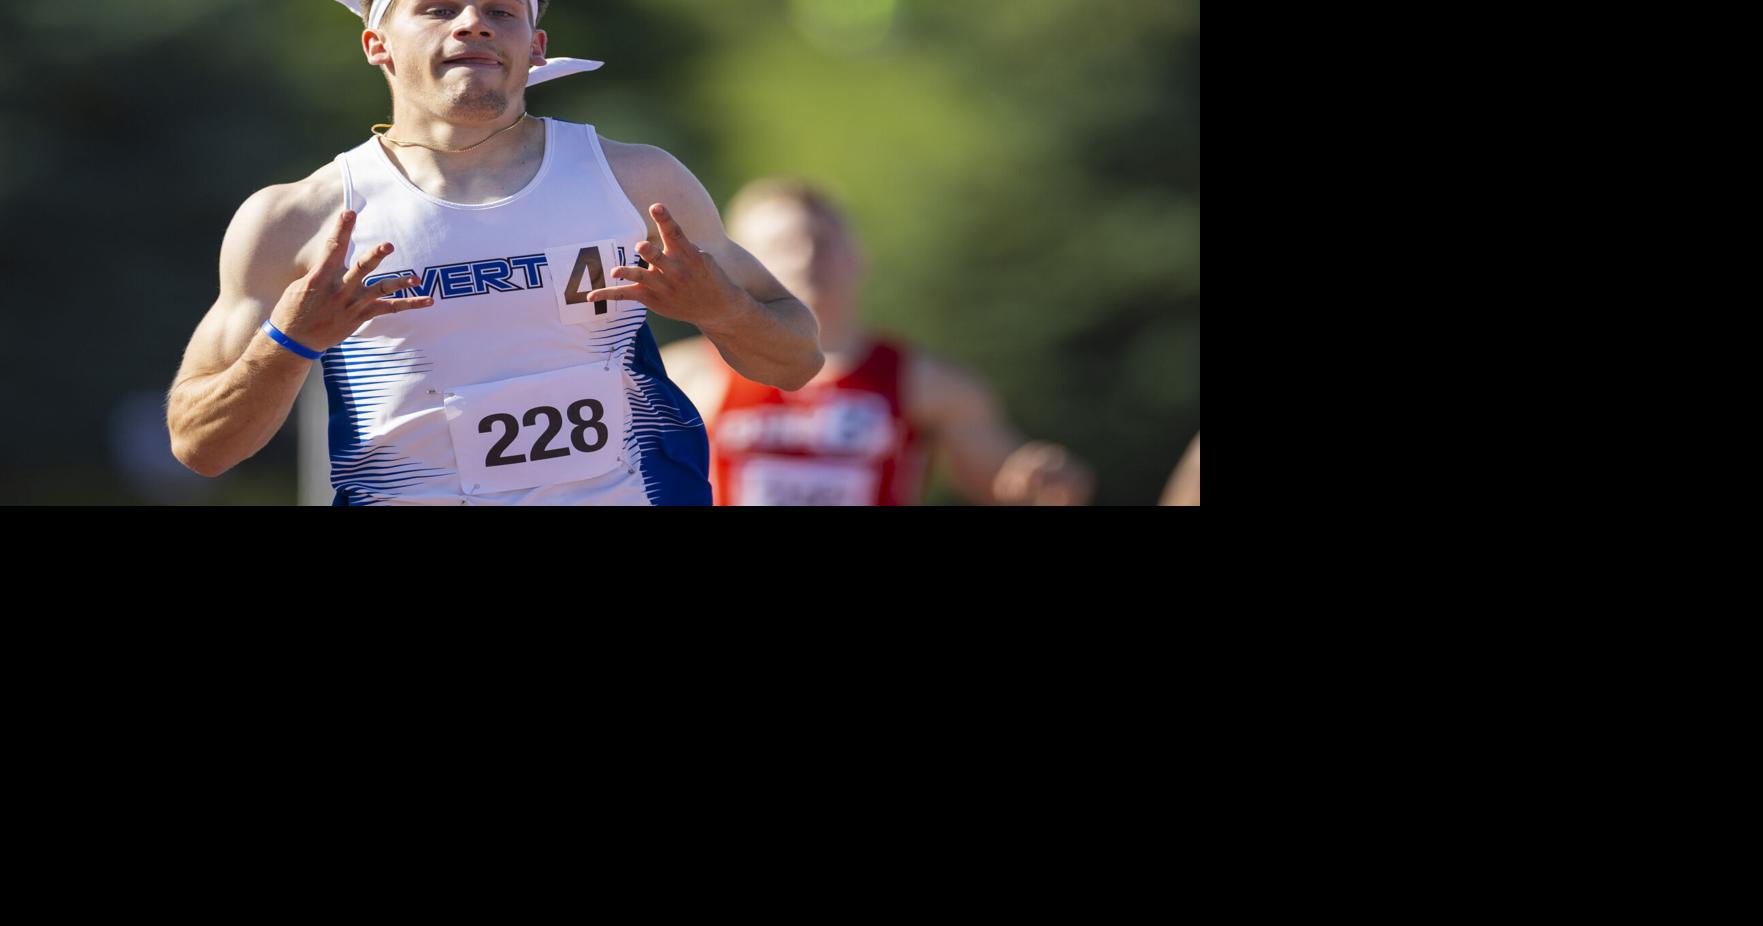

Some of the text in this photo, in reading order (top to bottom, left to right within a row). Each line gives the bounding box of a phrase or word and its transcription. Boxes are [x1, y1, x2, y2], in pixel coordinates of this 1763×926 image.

[362, 247, 626, 300] VERT
[564, 246, 608, 315] 4
[478, 399, 609, 467] 228
